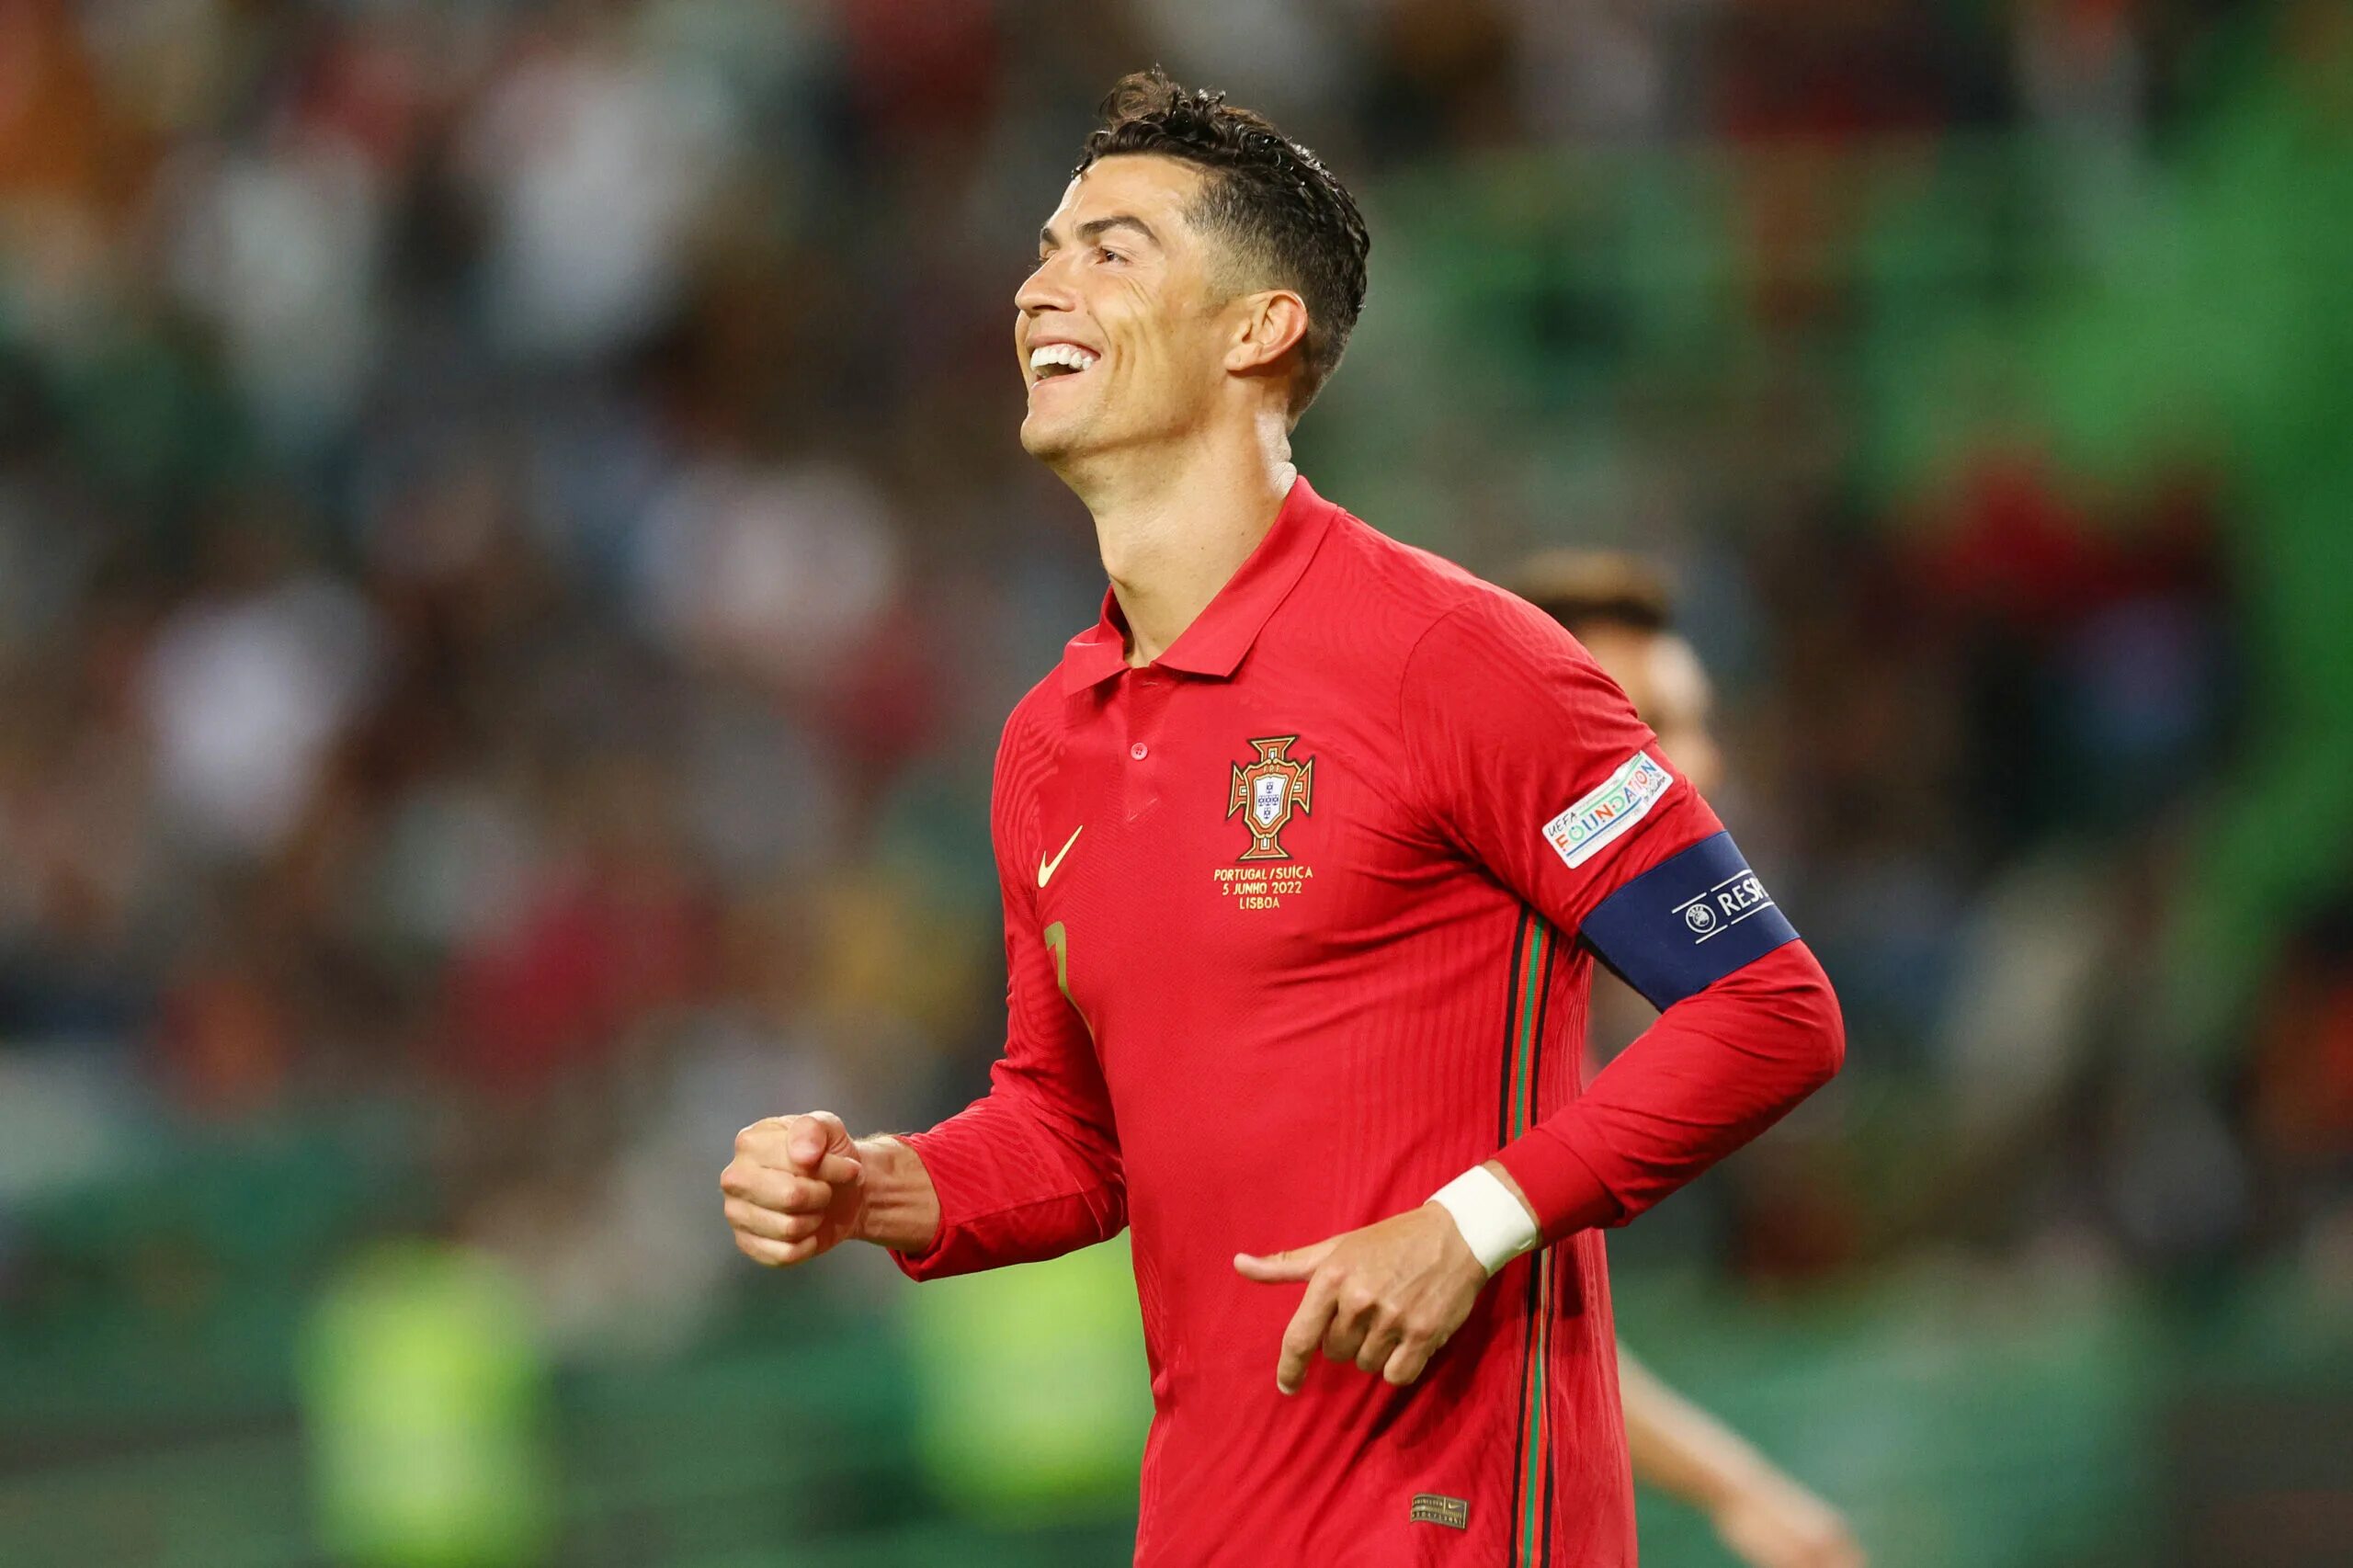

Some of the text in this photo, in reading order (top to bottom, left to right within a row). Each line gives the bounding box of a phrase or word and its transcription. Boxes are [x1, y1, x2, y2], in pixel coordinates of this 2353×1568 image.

[1555, 759, 1656, 852] FOUNDATION
[1548, 812, 1576, 837] UEFA
[1213, 869, 1267, 881] PORTUGAL
[1222, 881, 1302, 895] 5 JUNHO 2022
[1717, 877, 1769, 916] RESP
[1239, 897, 1280, 910] LISBOA
